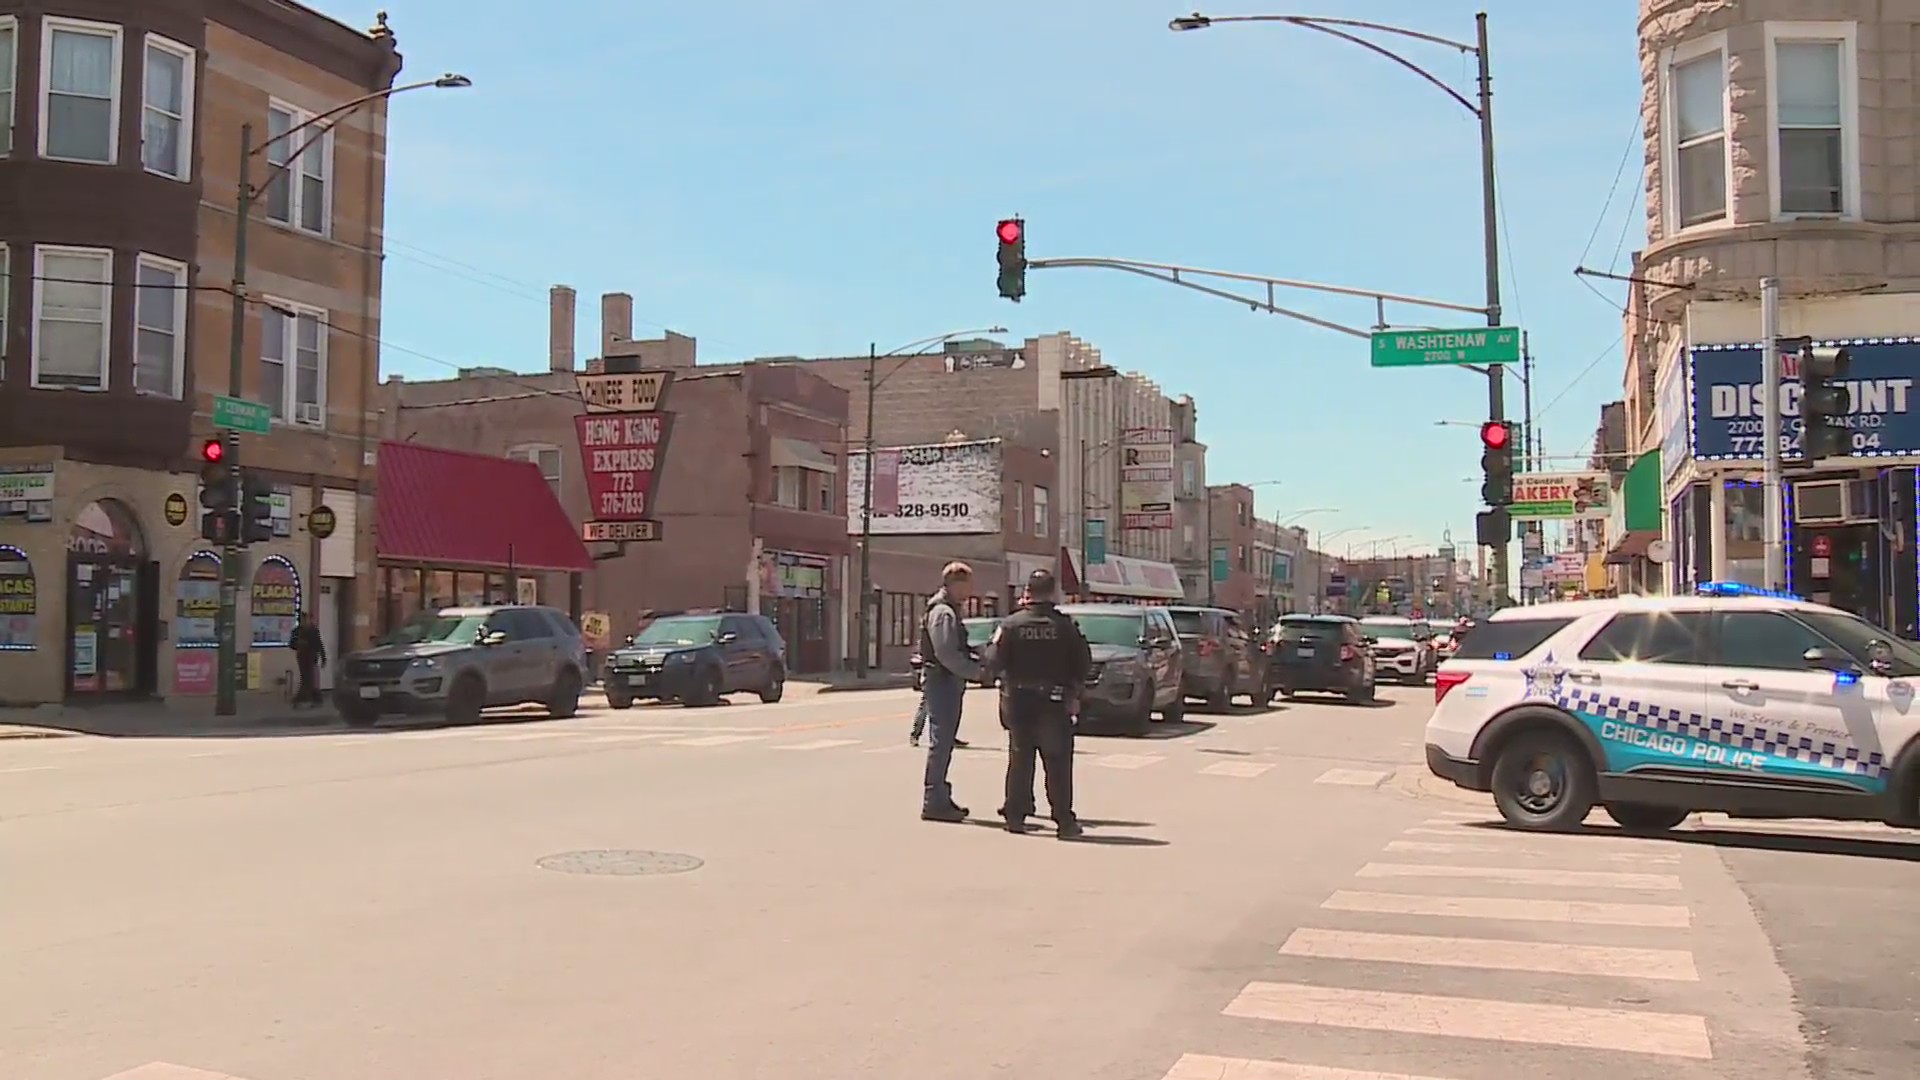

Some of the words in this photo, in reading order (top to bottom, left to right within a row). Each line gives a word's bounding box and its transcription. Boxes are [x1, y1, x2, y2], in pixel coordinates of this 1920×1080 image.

[1378, 339, 1386, 348] S
[1395, 333, 1486, 349] WASHTENAW
[1497, 334, 1511, 343] AV
[1424, 351, 1450, 361] 2700
[1457, 351, 1466, 360] W
[585, 380, 622, 404] CHINESE
[632, 379, 656, 403] FOOD
[1711, 379, 1912, 418] DISCUNT
[1859, 415, 1886, 429] RD.
[585, 420, 620, 445] HONG
[624, 418, 660, 444] KONG
[593, 450, 655, 471] EXPRESS
[612, 473, 634, 491] 773
[1515, 486, 1571, 500] AKERY
[601, 492, 644, 513] 376-7833
[590, 525, 604, 537] WE
[608, 524, 648, 537] DELIVER
[253, 584, 295, 598] PLACAS
[1020, 627, 1058, 639] POLICE
[1729, 708, 1746, 719] We
[1750, 713, 1784, 727] Serve
[1803, 722, 1853, 739] Protect
[1601, 721, 1686, 755] CHICAGO
[1691, 741, 1768, 768] POLICE
